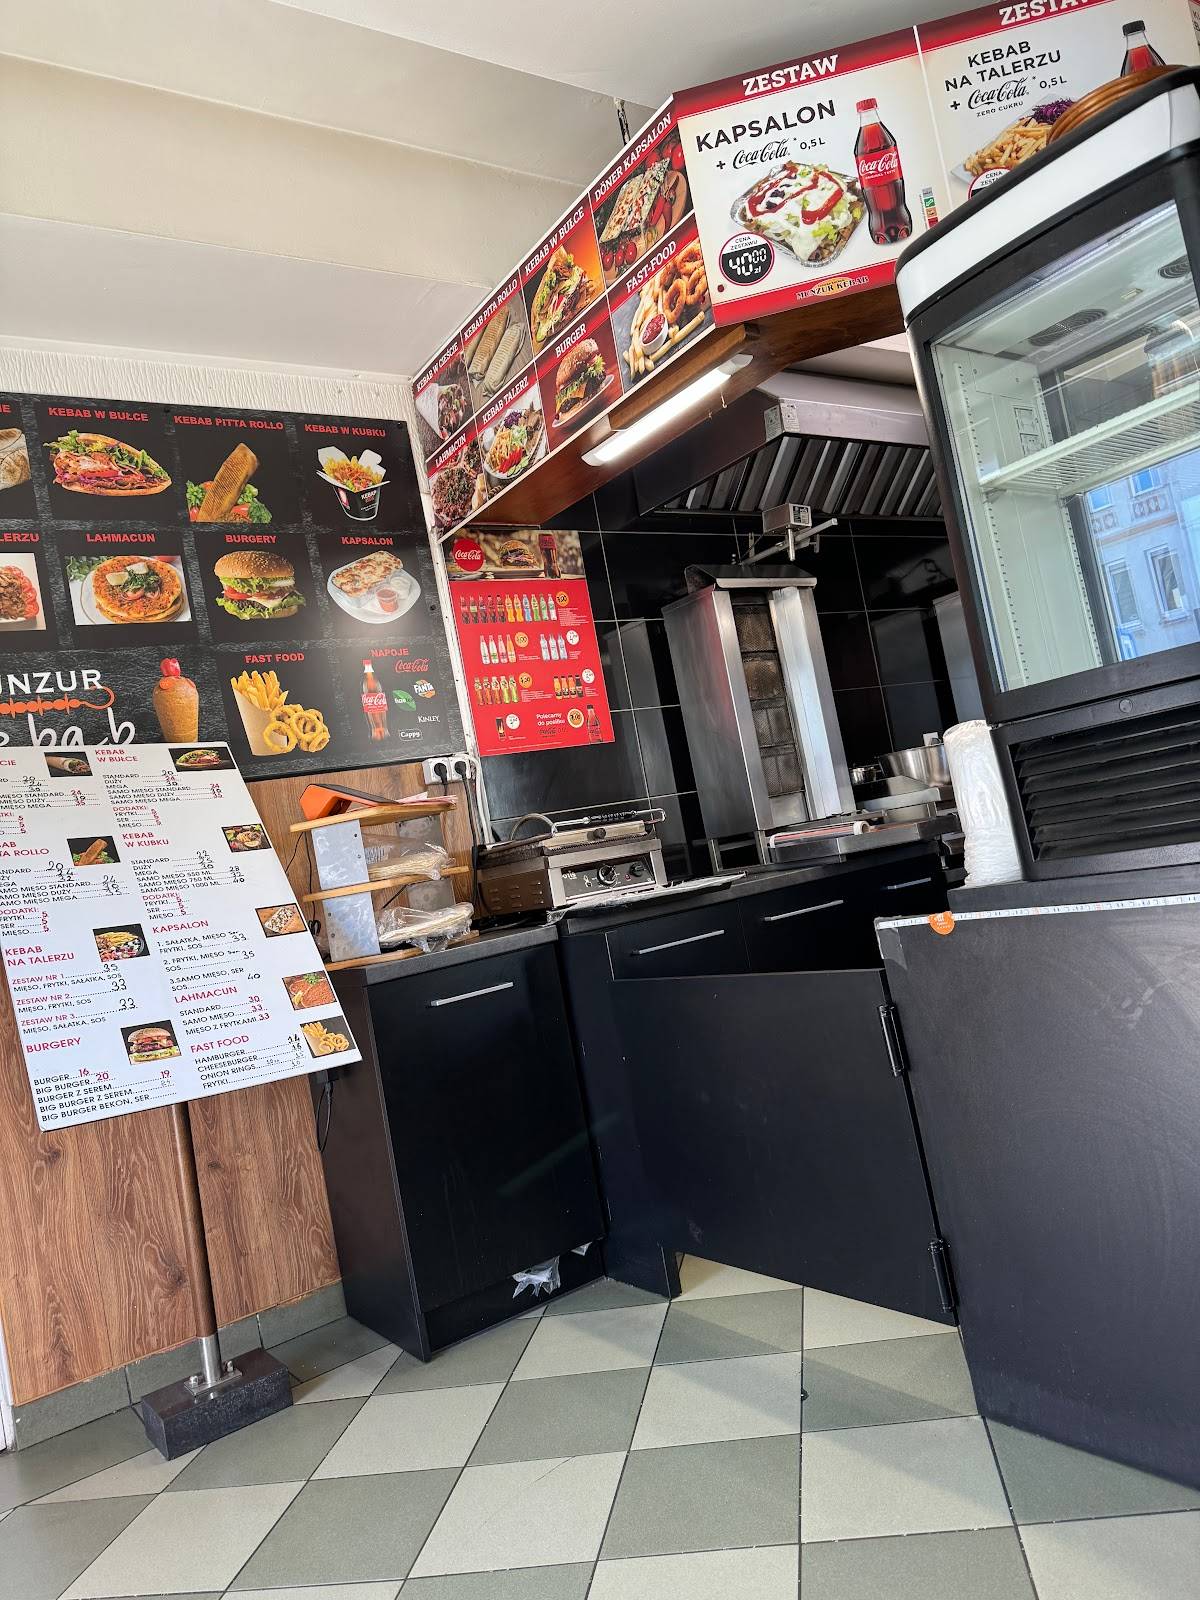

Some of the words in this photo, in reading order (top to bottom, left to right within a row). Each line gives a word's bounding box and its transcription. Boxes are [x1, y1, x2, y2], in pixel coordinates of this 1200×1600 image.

[968, 40, 1030, 68] KEBAB
[742, 55, 838, 96] ZESTAW
[944, 78, 973, 91] NA
[977, 50, 1061, 82] TALERZU
[976, 108, 996, 117] ZERO
[999, 101, 1024, 113] CUKRU
[695, 100, 836, 153] KAPSALON
[593, 166, 624, 202] DÖNER
[622, 113, 673, 171] KAPSALON
[731, 240, 758, 250] ZESTAWU
[525, 244, 550, 277] KEBAB
[549, 233, 558, 249] W
[626, 240, 677, 294] FAST-FOOD
[463, 315, 484, 342] KEBAB
[483, 301, 498, 321] PITA
[497, 279, 518, 306] ROLLO
[555, 323, 587, 359] BURGER
[416, 370, 433, 393] KEBAB
[482, 399, 504, 425] KEBAB
[503, 375, 529, 405] TALERZ
[48, 407, 92, 419] KEBAB
[94, 408, 107, 419] W
[173, 415, 213, 427] KEBAB
[215, 418, 247, 428] PITTA
[249, 420, 284, 430] ROLLO
[304, 424, 339, 435] KEBAB
[341, 425, 351, 435] W
[352, 427, 386, 438] KUBKU
[435, 433, 467, 468] LAHMACUN
[85, 533, 156, 543] LAHMACUN
[225, 534, 277, 545] BURGERY
[341, 536, 394, 546] KAPSALON
[245, 654, 273, 664] FAST
[275, 652, 305, 663] FOOD
[370, 648, 409, 658] NAPOJE
[122, 832, 154, 840] KEBAB
[138, 839, 170, 847] KUBKU
[14, 848, 50, 857] ROLLO
[131, 857, 170, 865] STANDARD
[49, 881, 91, 890] STANDARD
[152, 920, 209, 934] KAPSALON
[5, 945, 43, 956] KEBAB
[7, 958, 26, 967] NA
[29, 952, 75, 965] TALERZU
[165, 965, 182, 973] SOS
[12, 975, 44, 985] ZESTAW
[172, 984, 188, 992] SOS
[175, 986, 238, 1004] LAHMACUN
[16, 996, 49, 1006] ZESTAW
[76, 998, 92, 1006] SOS
[180, 1004, 221, 1017] STANDARD
[21, 1016, 54, 1027] ZESTAW
[55, 1014, 68, 1022] NR
[90, 1016, 107, 1024] SOS
[182, 1016, 208, 1026] SAMO
[220, 1017, 257, 1029] FRYTKAMI
[26, 1037, 81, 1054] BURGERY
[190, 1041, 214, 1053] FAST
[217, 1035, 250, 1049] FOOD
[195, 1049, 245, 1065] HAMBURGER
[197, 1055, 258, 1073] CHEESEBURGER
[200, 1070, 230, 1081] ONION
[231, 1063, 256, 1075] RINGS
[34, 1073, 70, 1086] BURGER
[203, 1079, 229, 1089] FRYTKI
[36, 1086, 52, 1095] BIG
[54, 1079, 90, 1093] BURGER
[37, 1091, 74, 1104] BURGER
[83, 1084, 114, 1096] SEREM
[39, 1104, 57, 1113] BIG
[59, 1096, 95, 1110] BURGER
[104, 1089, 133, 1101] SEREM
[42, 1114, 59, 1123] BIG
[61, 1106, 98, 1119] BURGER
[134, 1094, 151, 1105] SER
